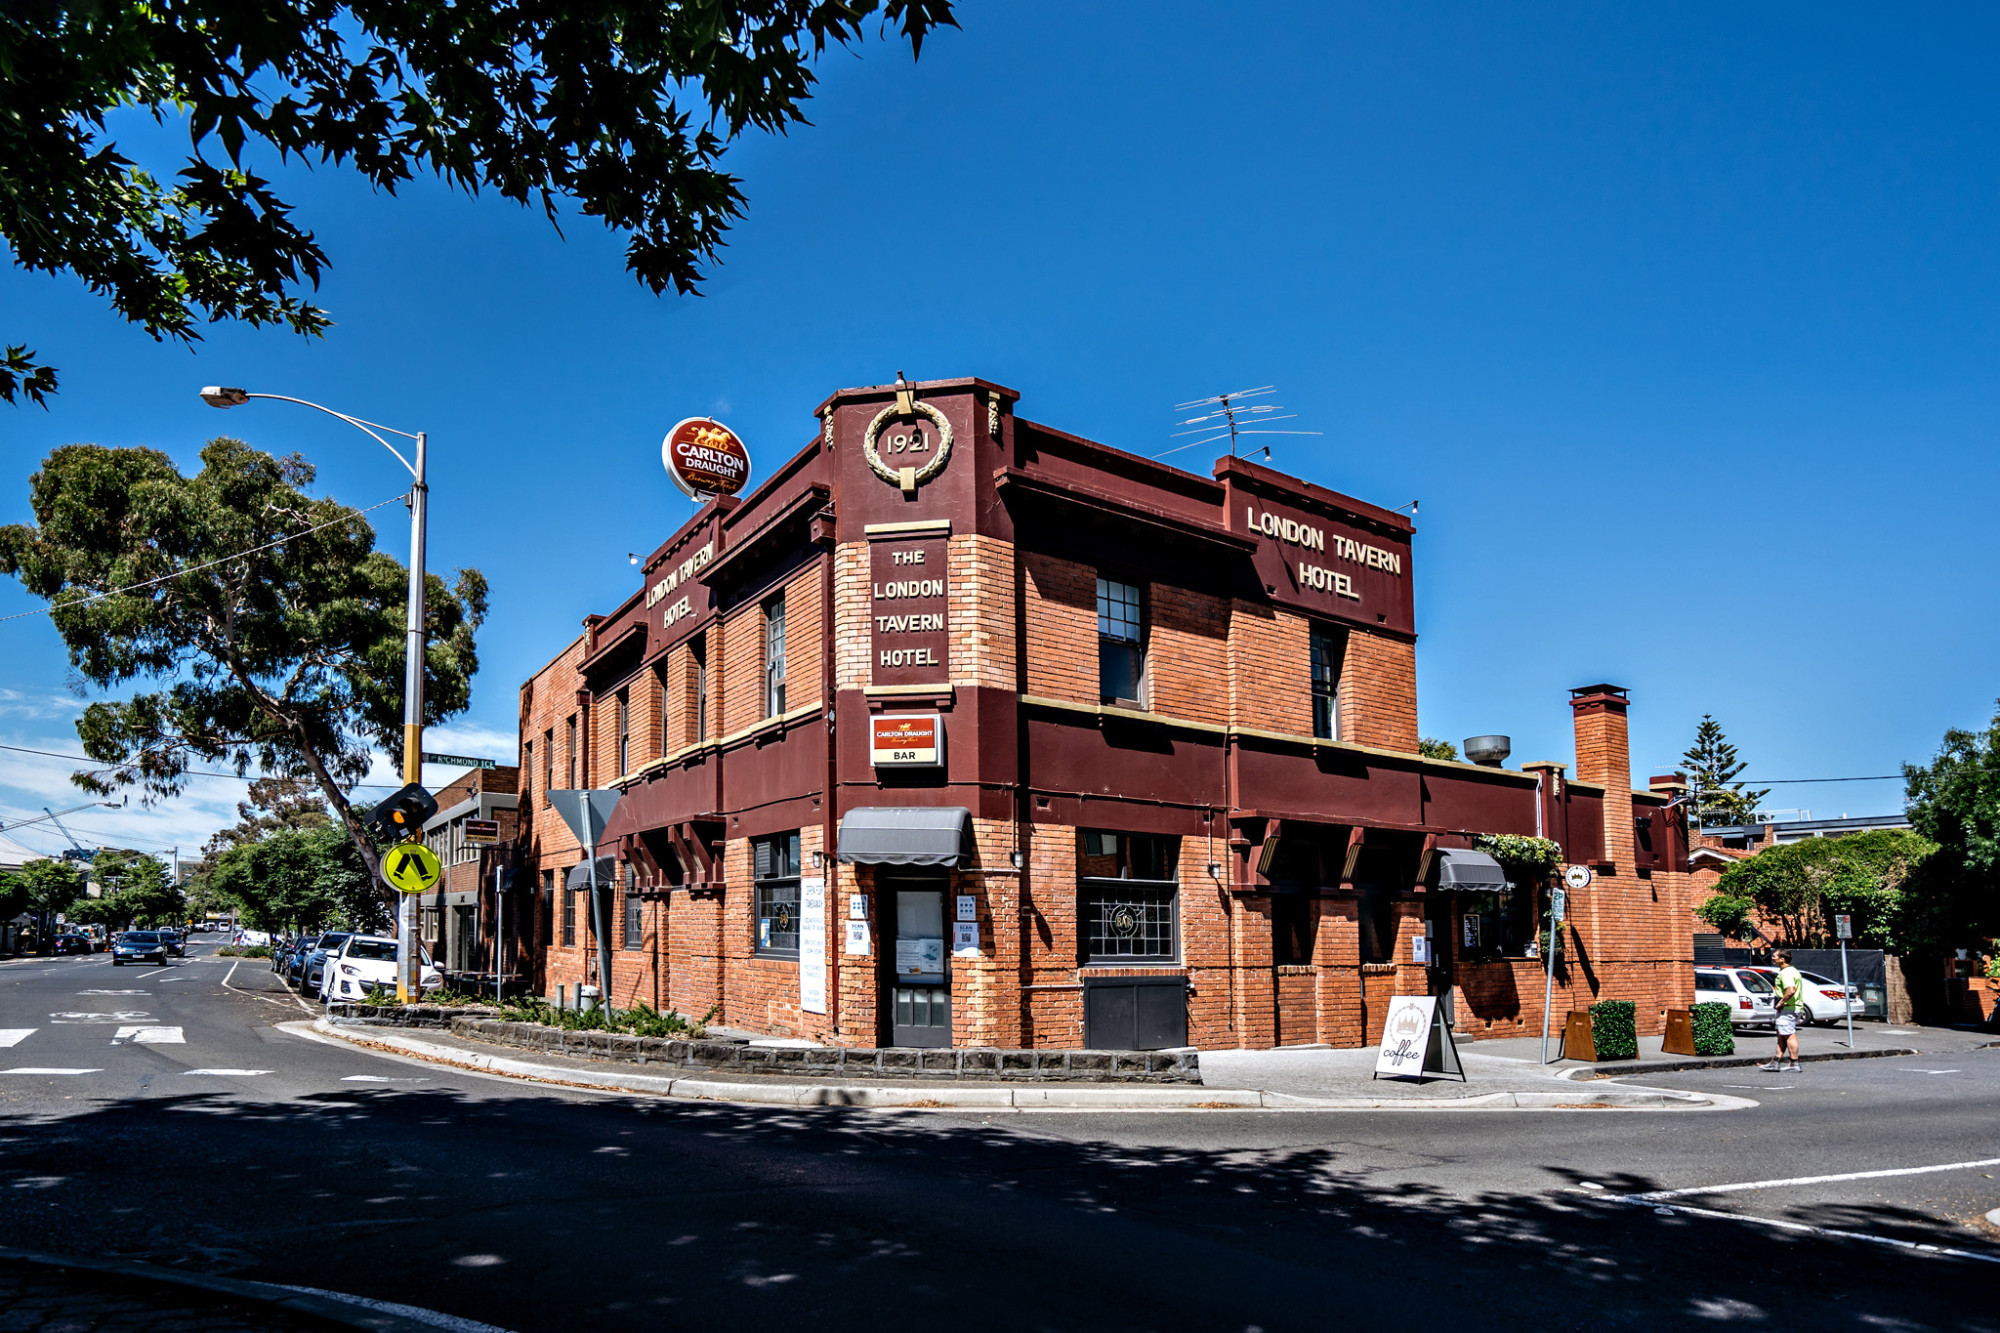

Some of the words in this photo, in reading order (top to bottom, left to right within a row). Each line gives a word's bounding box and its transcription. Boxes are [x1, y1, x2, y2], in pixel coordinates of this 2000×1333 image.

[887, 432, 929, 454] 1921
[676, 443, 744, 471] CARLTON
[685, 458, 737, 478] DRAUGHT
[1247, 506, 1324, 551] LONDON
[1332, 534, 1401, 575] TAVERN
[891, 550, 925, 565] THE
[646, 570, 678, 609] LONDON
[679, 540, 714, 583] TAVERN
[1299, 562, 1359, 599] HOTEL
[874, 579, 944, 599] LONDON
[664, 595, 692, 629] HOTEL
[874, 613, 944, 633] TAVERN
[880, 648, 939, 667] HOTEL
[437, 756, 479, 767] RICHMOND
[893, 751, 916, 760] BAR
[1383, 1039, 1420, 1066] coffee
